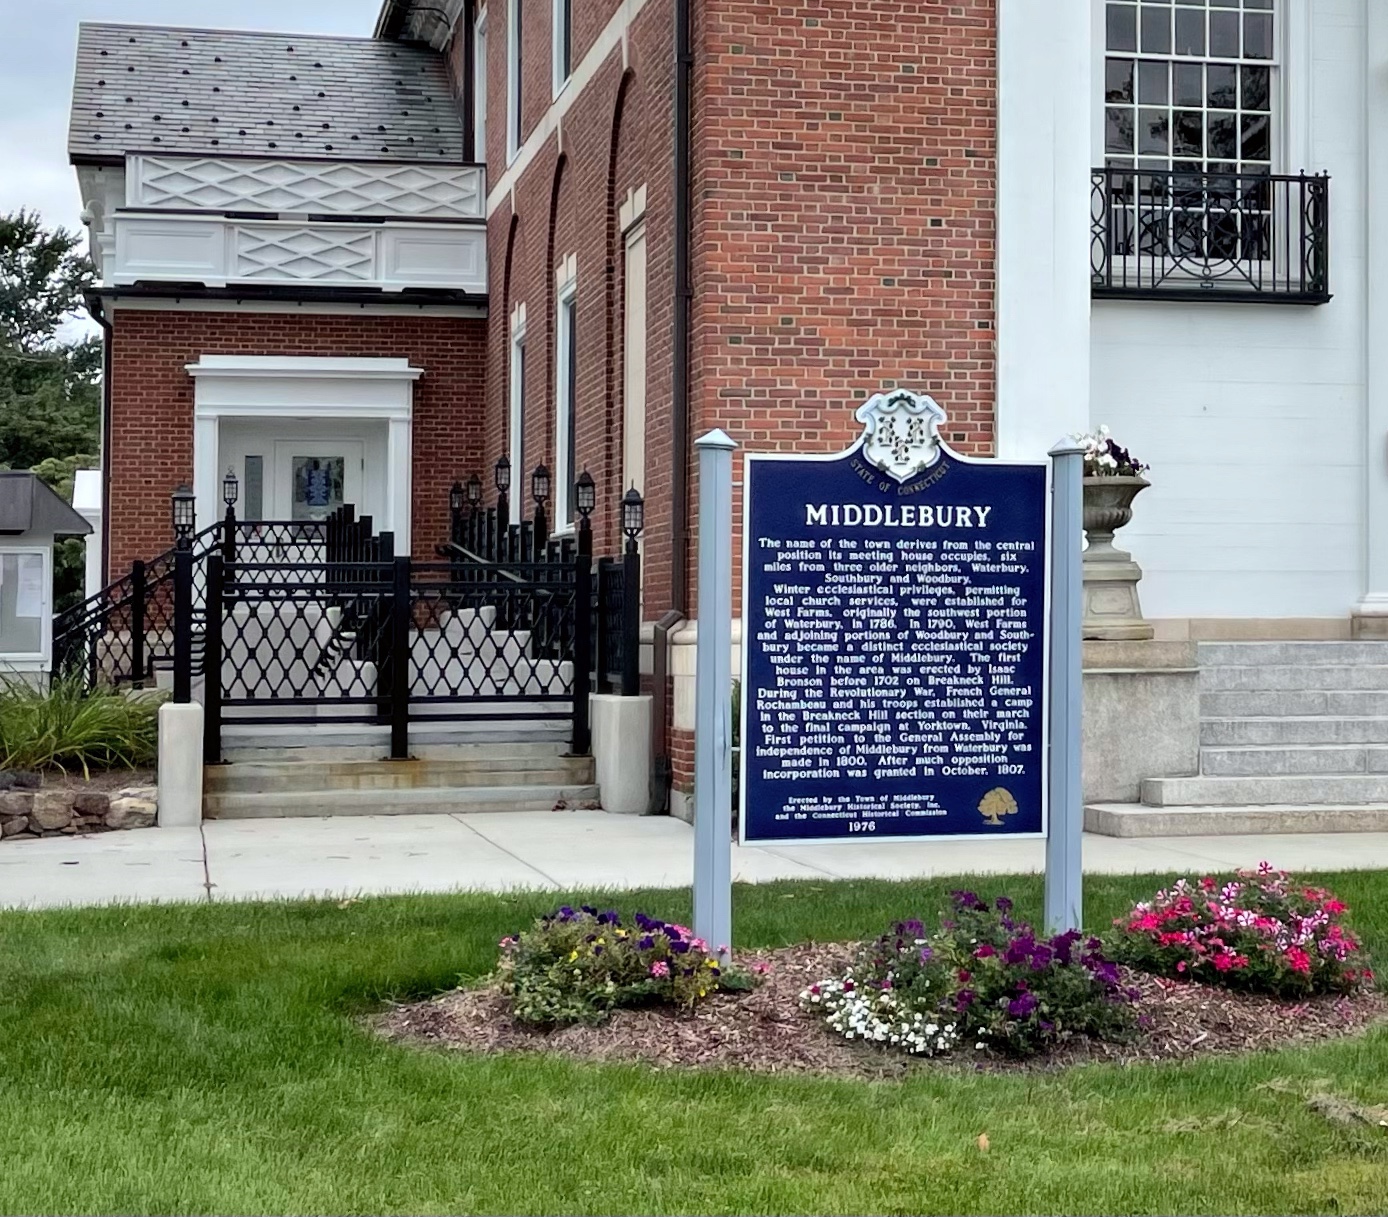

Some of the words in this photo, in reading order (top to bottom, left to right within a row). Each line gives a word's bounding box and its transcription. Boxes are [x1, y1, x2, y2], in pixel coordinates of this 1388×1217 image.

[850, 458, 876, 484] STATE
[879, 481, 891, 492] OF
[897, 460, 950, 495] CONNECTICUT
[805, 504, 991, 528] MIDDLEBURY
[758, 538, 781, 548] The
[786, 540, 815, 548] name
[820, 539, 832, 548] of
[838, 539, 857, 548] the
[864, 540, 891, 549] town
[896, 539, 937, 549] derives
[943, 540, 968, 550] from
[975, 540, 991, 550] the
[996, 541, 1034, 550] central
[777, 549, 822, 561] position
[829, 550, 842, 560] its
[849, 550, 893, 561] meeting
[901, 551, 933, 561] house
[1001, 552, 1017, 561] six
[764, 562, 791, 571] miles
[799, 561, 825, 571] from
[833, 562, 863, 572] three
[869, 562, 898, 572] older
[825, 573, 883, 584] Southbury
[890, 574, 910, 583] and
[773, 584, 811, 594] Winter
[817, 584, 893, 594] ecclesiastical
[965, 585, 1020, 596] permitting
[765, 595, 794, 606] local
[802, 596, 841, 606] church
[911, 598, 937, 606] were
[945, 596, 1004, 606] established
[1011, 597, 1027, 606] for
[765, 607, 790, 617] West
[843, 607, 897, 618] originally
[903, 608, 920, 617] the
[927, 608, 980, 617] southwest
[987, 608, 1027, 618] portion
[765, 619, 777, 629] of
[852, 618, 865, 629] in
[910, 619, 920, 629] In
[965, 619, 989, 628] West
[996, 619, 1027, 628] Farms
[757, 631, 777, 640] and
[784, 630, 838, 641] adjoining
[844, 630, 890, 641] portions
[897, 630, 909, 640] of
[915, 630, 969, 641] Woodbury
[974, 630, 994, 640] and
[1000, 630, 1034, 639] South-
[762, 642, 789, 653] bury
[797, 641, 839, 652] became
[845, 641, 853, 651] a
[861, 641, 904, 651] distinct
[911, 641, 983, 651] ecclesiastical
[990, 641, 1028, 652] society
[770, 653, 803, 663] under
[811, 654, 829, 663] the
[836, 655, 866, 663] name
[872, 653, 884, 663] of
[970, 653, 991, 662] The
[998, 652, 1020, 662] first
[776, 665, 809, 675] house
[816, 665, 826, 675] in
[834, 665, 852, 674] the
[859, 666, 884, 674] area
[920, 664, 961, 674] erected
[968, 664, 981, 674] by
[989, 664, 1015, 674] Isaac
[777, 676, 823, 686] Bronson
[831, 676, 867, 686] before
[874, 675, 899, 686] 1702
[906, 677, 920, 685] on
[928, 675, 984, 685] Breakneck
[758, 688, 797, 699] During
[804, 688, 823, 698] the
[830, 687, 906, 698] Revolutionary
[946, 686, 982, 696] French
[989, 686, 1031, 696] General
[757, 699, 826, 710] Rochambeau
[833, 699, 853, 709] and
[860, 699, 875, 709] his
[882, 699, 918, 709] troops
[924, 697, 984, 708] established
[1005, 699, 1033, 708] camp
[760, 711, 771, 721] in
[778, 712, 796, 721] the
[802, 710, 861, 721] Breakneck
[869, 710, 888, 720] Hill
[895, 709, 935, 719] section
[942, 711, 955, 719] on
[963, 709, 989, 718] their
[996, 709, 1029, 718] march
[762, 724, 774, 733] to
[780, 723, 799, 733] the
[805, 722, 830, 732] final
[838, 721, 891, 733] campaign
[899, 722, 909, 731] at
[765, 734, 791, 745] First
[800, 733, 845, 744] petition
[854, 733, 865, 743] to
[874, 732, 891, 743] the
[900, 732, 943, 742] General
[950, 731, 1001, 743] Assembly
[1008, 731, 1024, 741] for
[756, 744, 833, 757] independence
[839, 745, 851, 755] of
[856, 743, 918, 755] Middlebury
[923, 743, 949, 753] from
[954, 743, 1008, 754] Waterbury
[782, 757, 812, 767] made
[819, 757, 829, 766] in
[878, 755, 908, 765] After
[915, 755, 943, 765] much
[951, 754, 1008, 765] opposition
[763, 768, 840, 780] incorporation
[847, 769, 867, 777] was
[874, 766, 916, 778] granted
[924, 766, 934, 776] in
[849, 821, 875, 832] 1976
